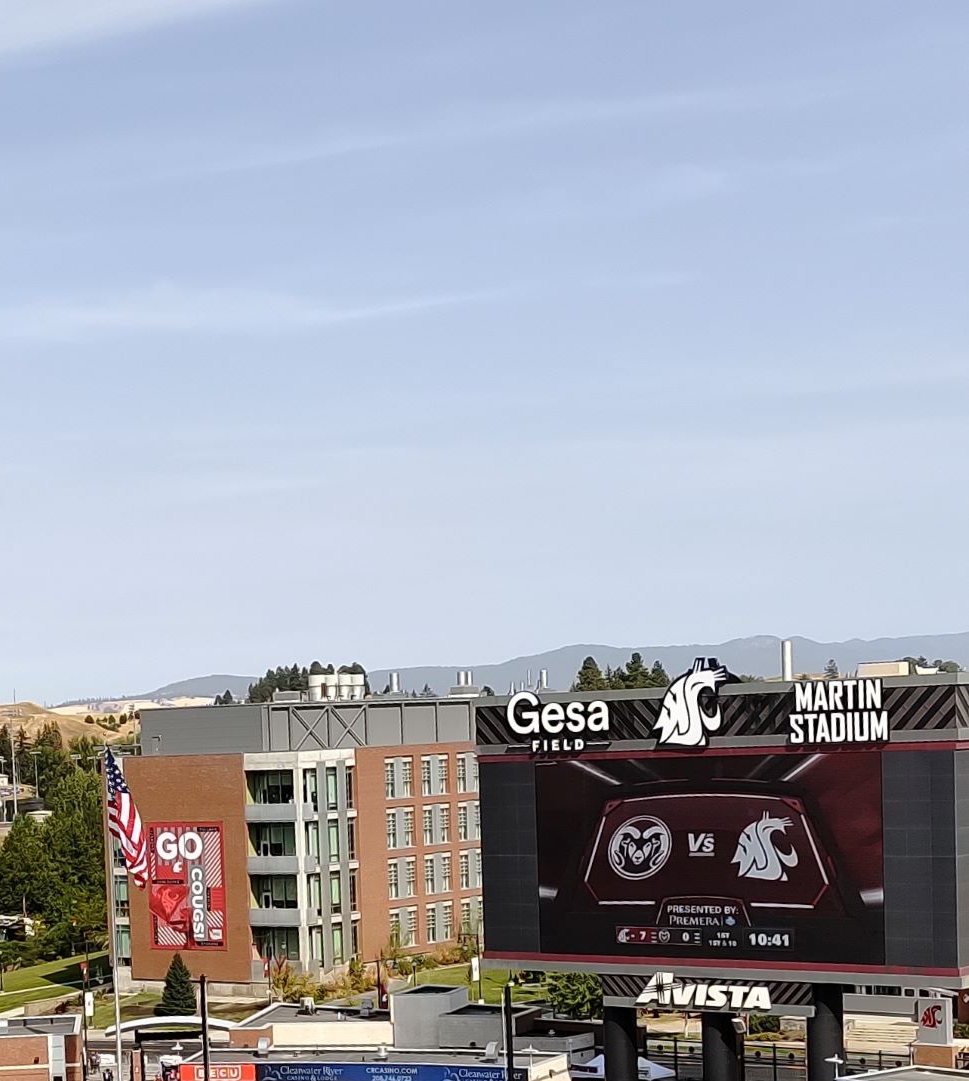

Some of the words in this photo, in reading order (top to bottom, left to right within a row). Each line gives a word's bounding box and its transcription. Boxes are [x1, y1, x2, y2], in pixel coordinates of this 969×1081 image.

[795, 679, 882, 712] MARTIN
[507, 691, 610, 735] Gesa
[789, 710, 889, 744] STADIUM
[532, 738, 585, 753] FIELD
[156, 831, 203, 860] GO
[191, 867, 205, 939] COUGS!
[667, 905, 722, 914] PRESENTED
[723, 905, 739, 915] BY:
[669, 916, 720, 926] PREMERA
[639, 931, 647, 941] 7
[681, 931, 690, 942] 0
[749, 933, 790, 947] 10:41
[198, 1068, 238, 1078] BECU
[280, 1066, 322, 1075] Clearwater
[322, 1066, 343, 1076] River
[458, 1069, 501, 1079] Clearwater
